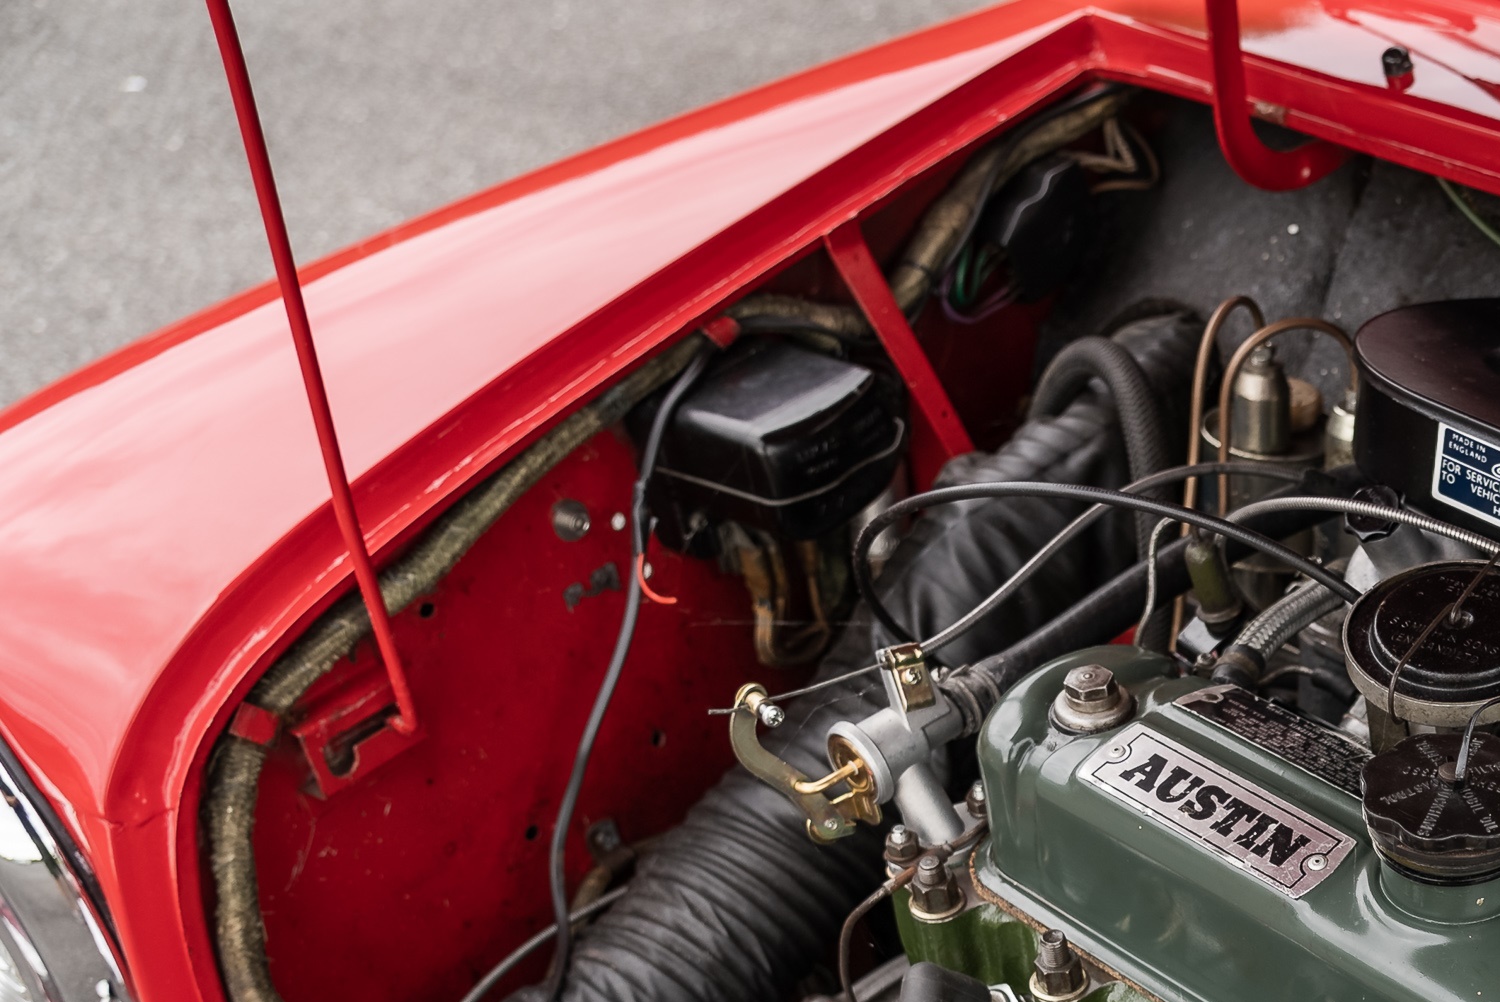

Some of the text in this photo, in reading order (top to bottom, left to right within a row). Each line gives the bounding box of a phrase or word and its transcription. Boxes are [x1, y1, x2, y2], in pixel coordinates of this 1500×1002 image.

[1449, 442, 1487, 463] ENGLAND
[1452, 433, 1486, 453] MADE IN
[1442, 459, 1461, 476] FOR
[1442, 471, 1456, 484] TO
[1119, 753, 1312, 868] AUSTIN
